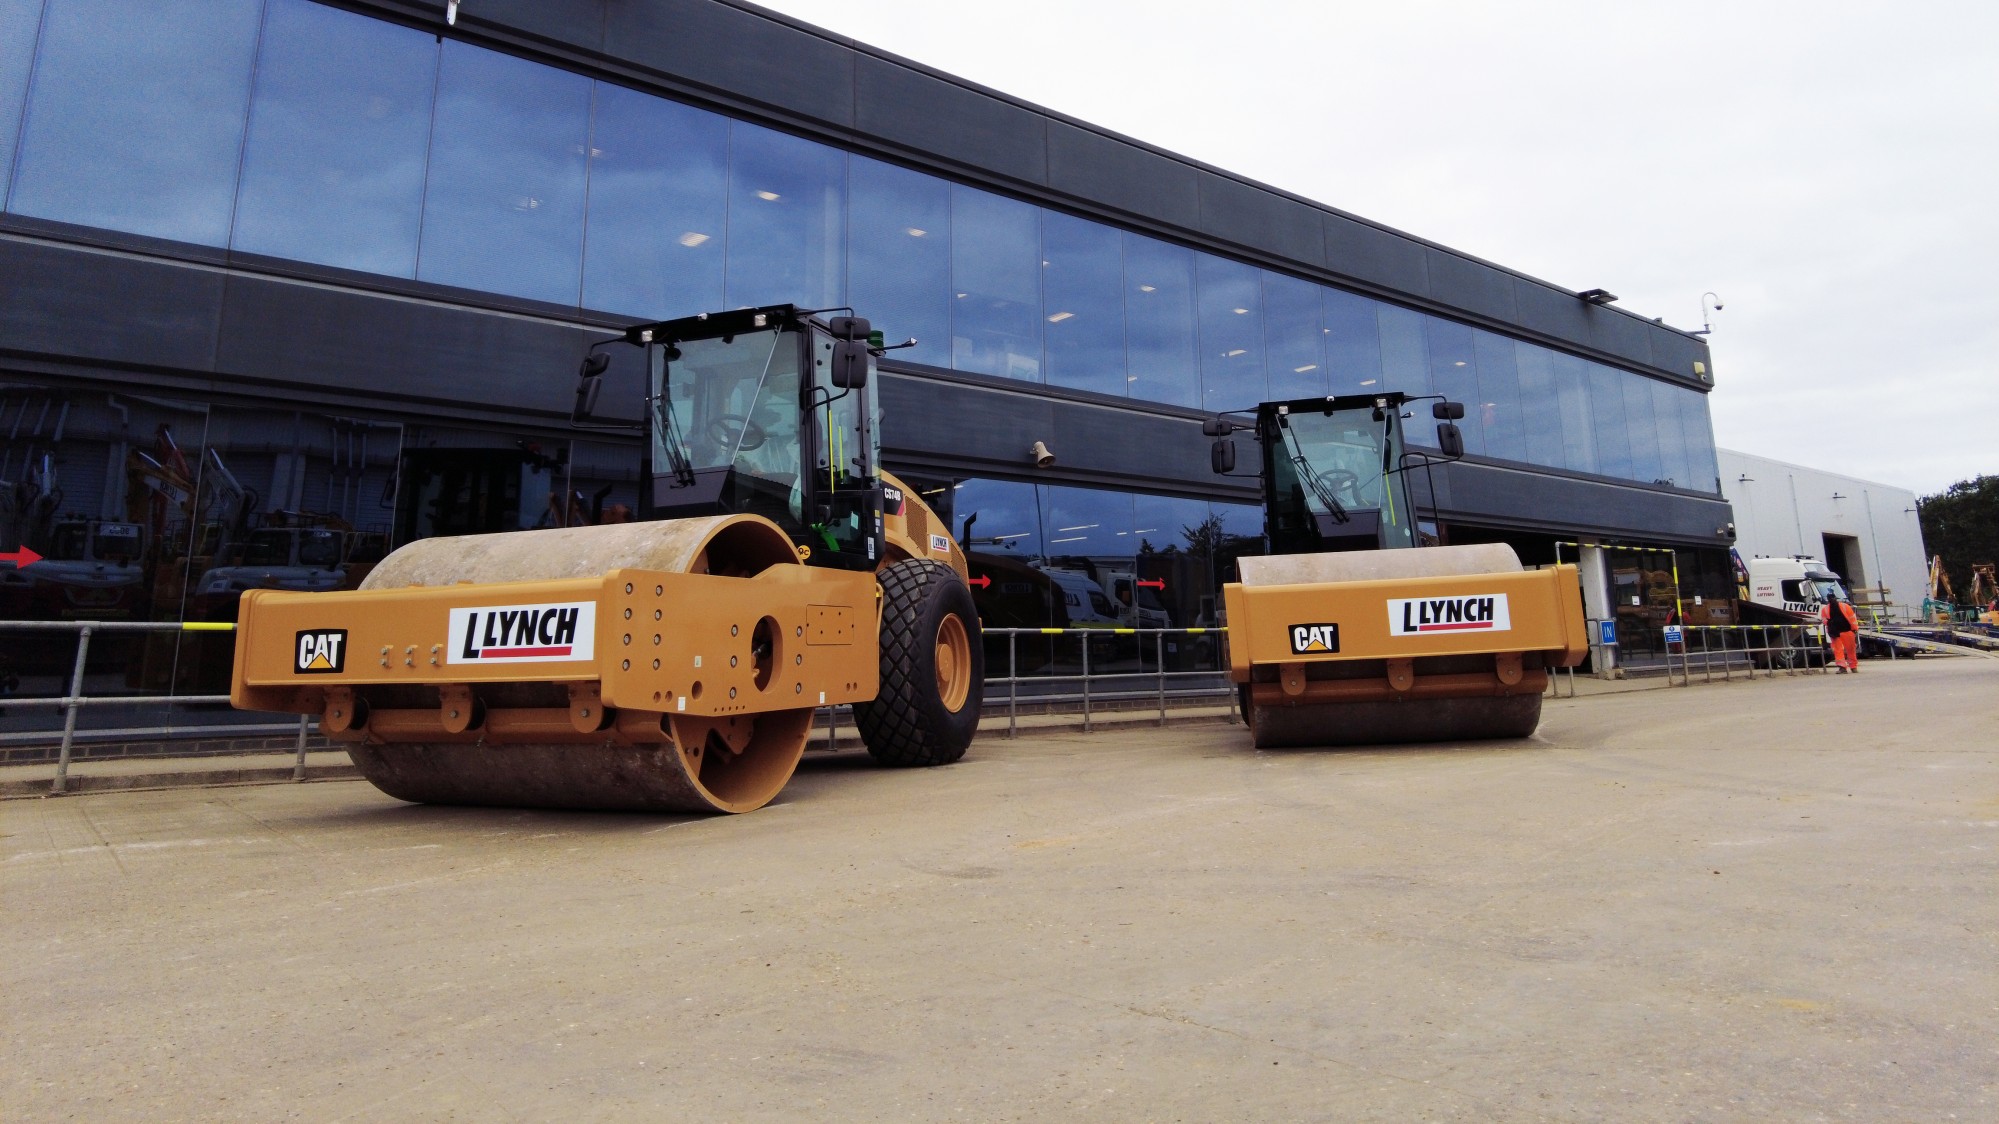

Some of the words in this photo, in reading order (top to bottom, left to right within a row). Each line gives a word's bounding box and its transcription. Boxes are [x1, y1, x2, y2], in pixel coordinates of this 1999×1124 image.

[1789, 602, 1819, 612] LYNCH
[1294, 625, 1335, 652] CAT
[1604, 626, 1613, 638] IN
[299, 633, 343, 670] CAT
